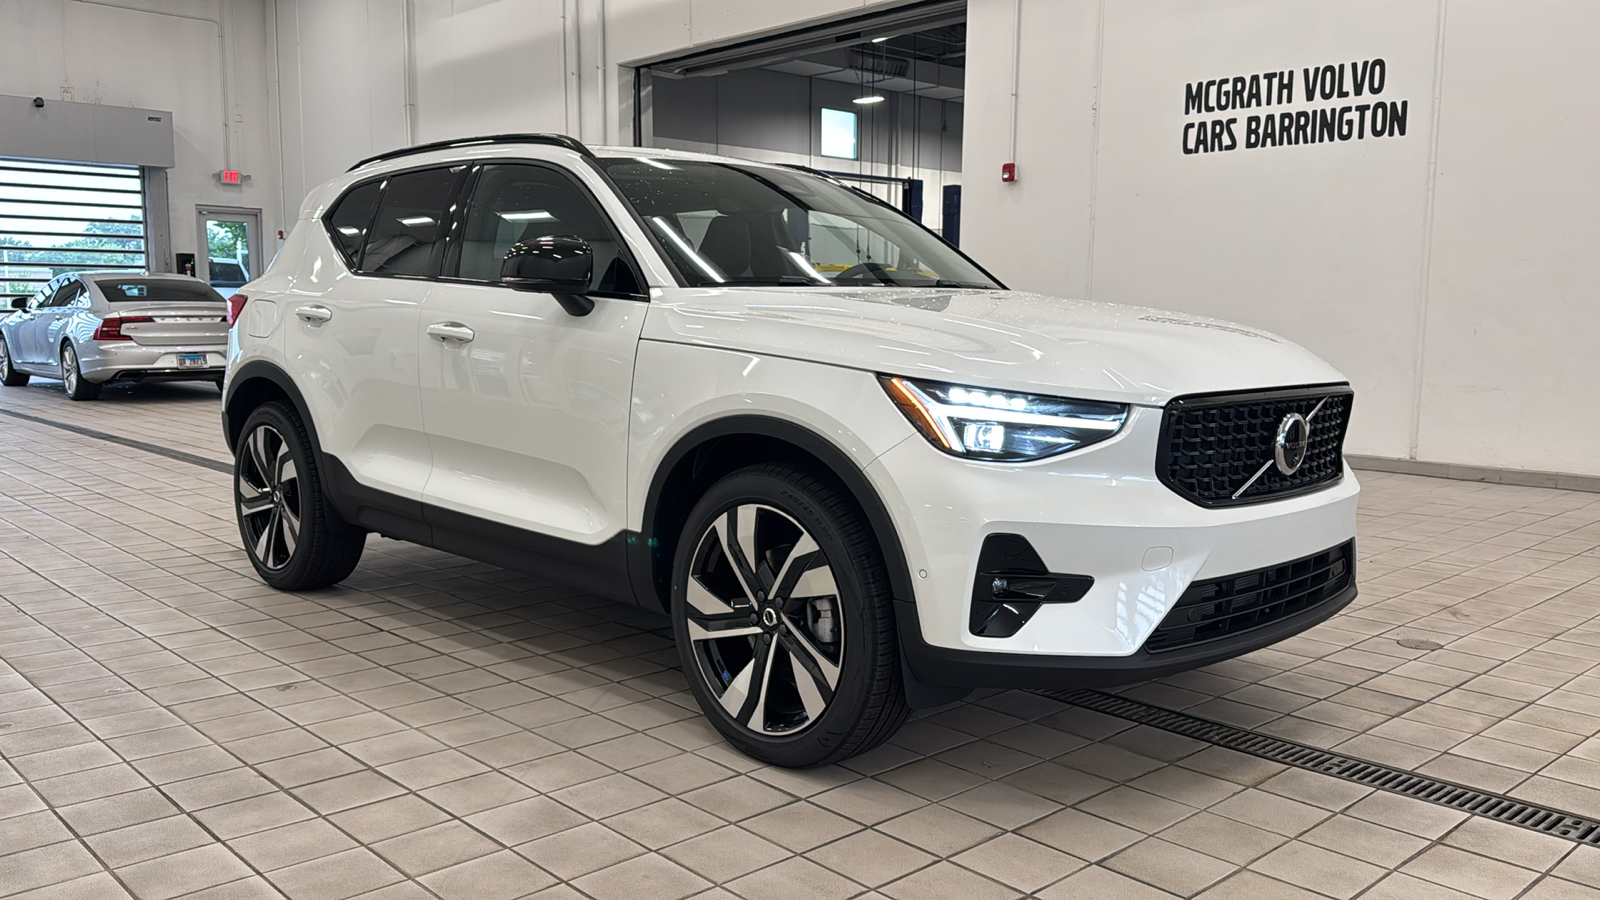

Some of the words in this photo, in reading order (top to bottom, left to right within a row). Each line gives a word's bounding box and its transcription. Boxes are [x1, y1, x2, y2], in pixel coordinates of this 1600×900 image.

[1185, 70, 1294, 115] MCGRATH
[1303, 58, 1386, 102] VOLVO
[1182, 118, 1237, 155] CARS
[1245, 100, 1408, 149] BARRINGTON
[223, 170, 239, 183] EXIT
[1285, 440, 1306, 450] VOLVO
